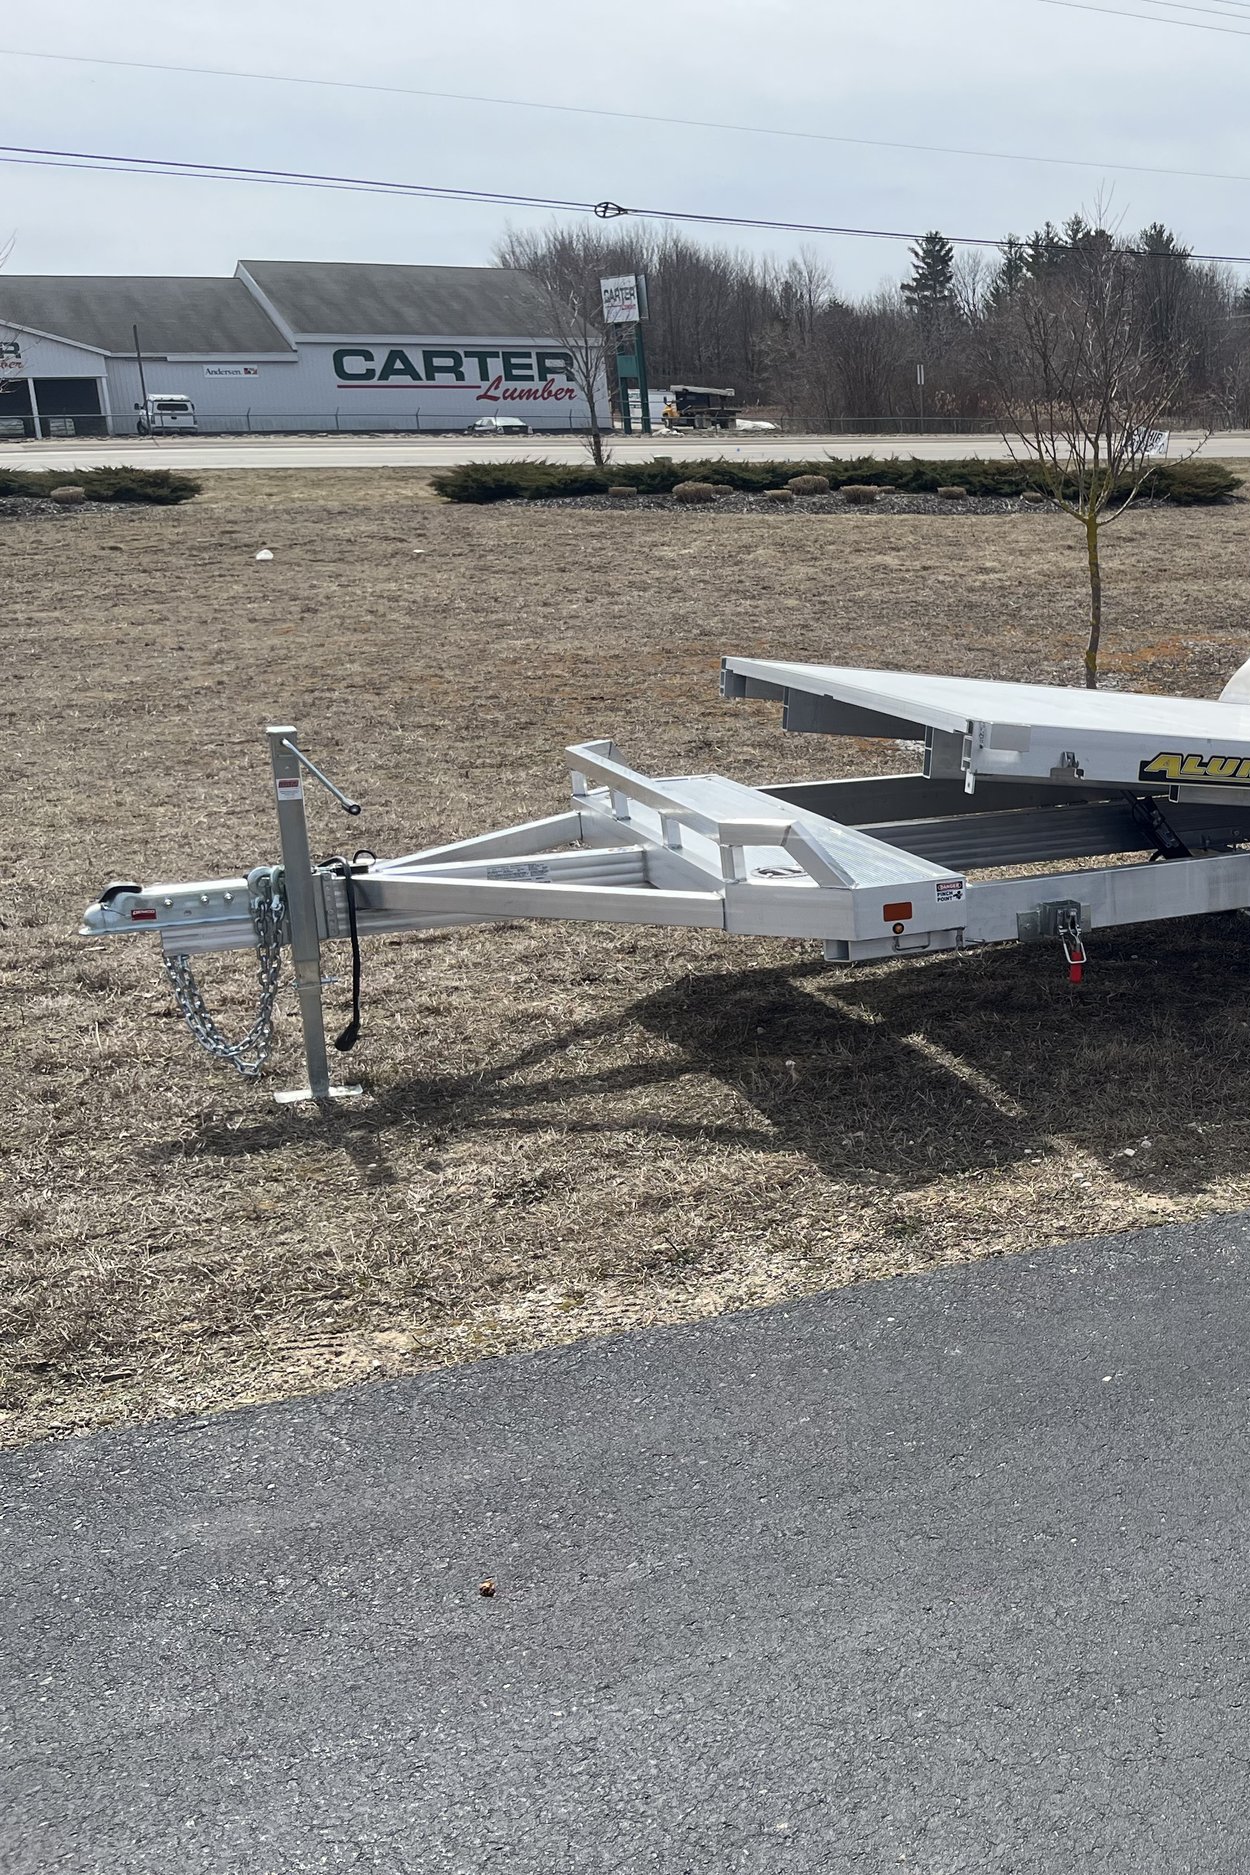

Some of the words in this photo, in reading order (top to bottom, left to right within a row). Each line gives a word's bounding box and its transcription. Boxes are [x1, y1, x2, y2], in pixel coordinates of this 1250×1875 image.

[603, 286, 636, 303] CARTER
[332, 348, 576, 382] CARTER
[476, 375, 578, 401] Lumber
[940, 882, 960, 890] DANGER
